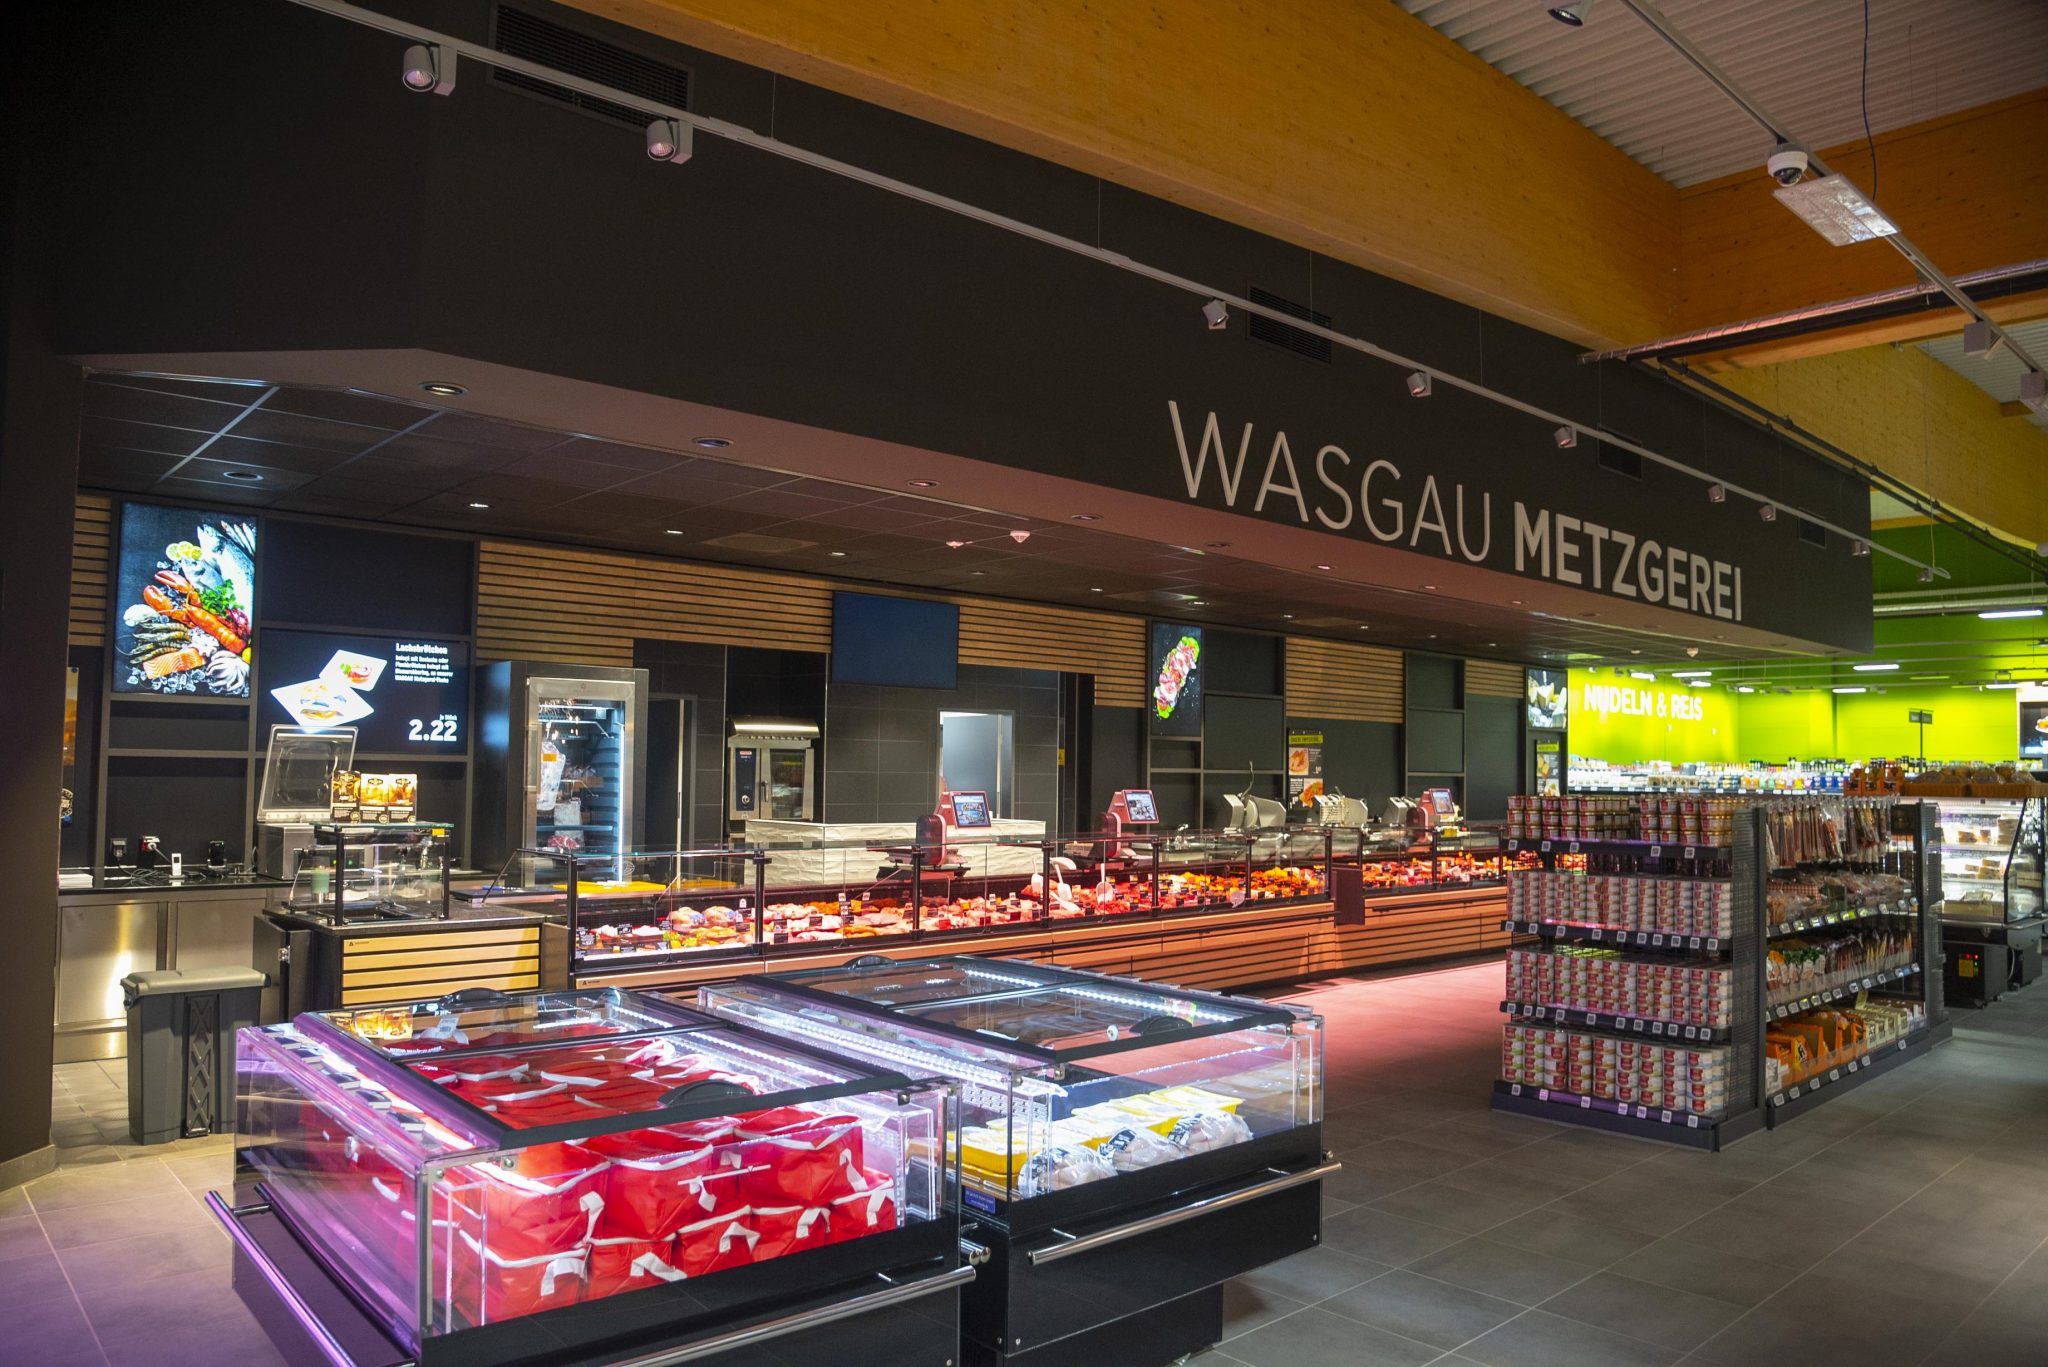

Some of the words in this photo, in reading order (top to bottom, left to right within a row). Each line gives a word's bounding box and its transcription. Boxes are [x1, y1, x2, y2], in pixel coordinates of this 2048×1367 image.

[1168, 400, 1490, 562] WASGAU
[1515, 501, 1742, 621] METZGEREI
[1584, 684, 1652, 716] NUDELN
[1656, 692, 1667, 717] &
[1671, 694, 1703, 720] REIS
[409, 719, 457, 742] 2.22
